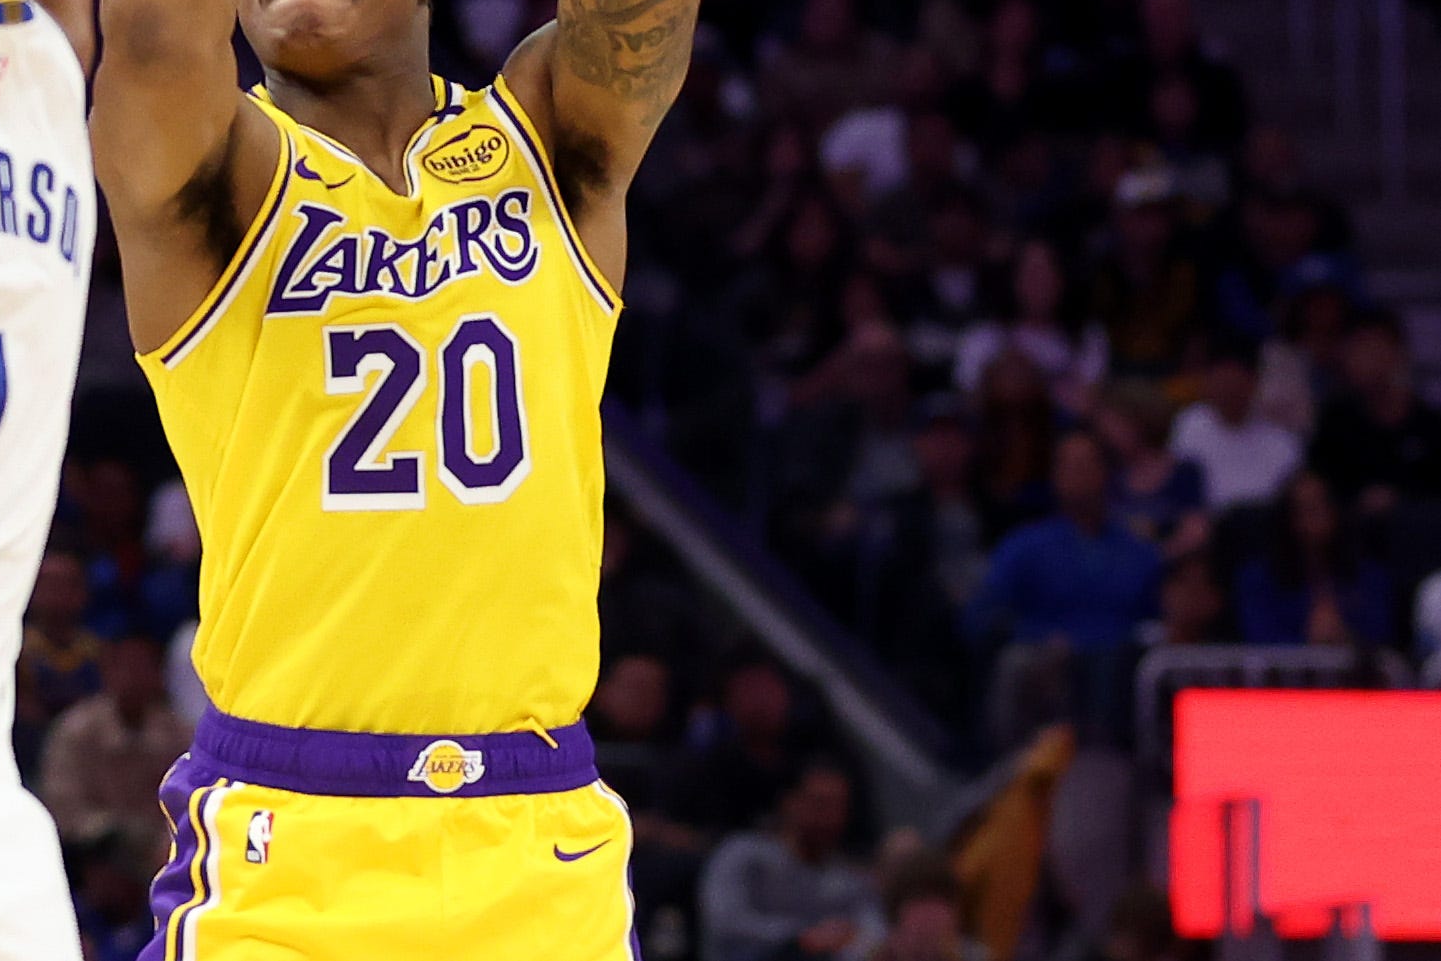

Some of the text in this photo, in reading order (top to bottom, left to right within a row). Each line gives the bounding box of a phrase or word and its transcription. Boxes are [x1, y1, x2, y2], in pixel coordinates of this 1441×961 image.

[429, 137, 502, 171] bibigo
[265, 188, 540, 315] LAKERS
[323, 314, 530, 506] 20
